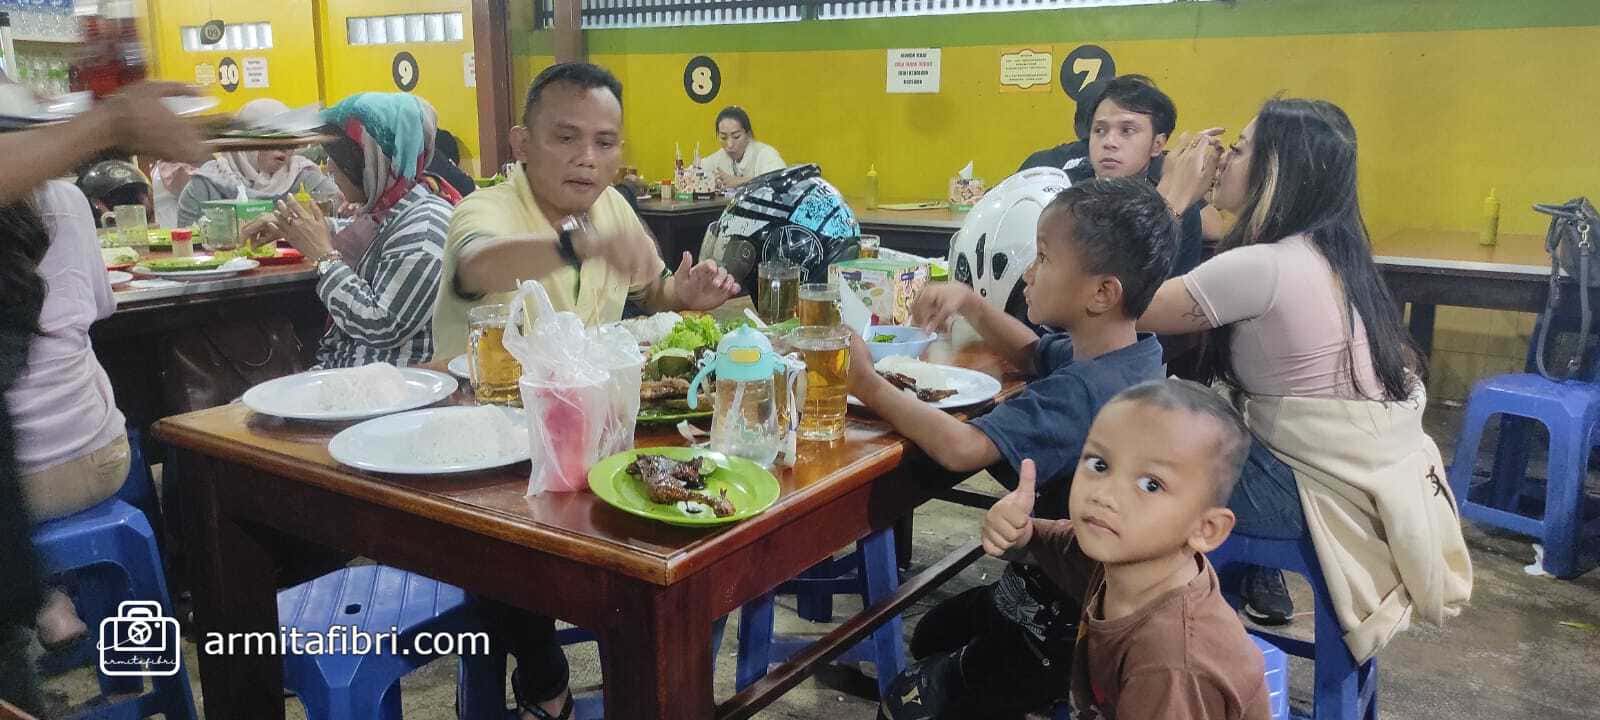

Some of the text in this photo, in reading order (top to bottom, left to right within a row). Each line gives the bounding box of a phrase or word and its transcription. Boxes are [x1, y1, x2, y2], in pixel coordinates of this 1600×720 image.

[219, 64, 239, 86] 10
[398, 59, 413, 86] 9
[691, 66, 713, 95] 8
[1072, 58, 1103, 92] 7
